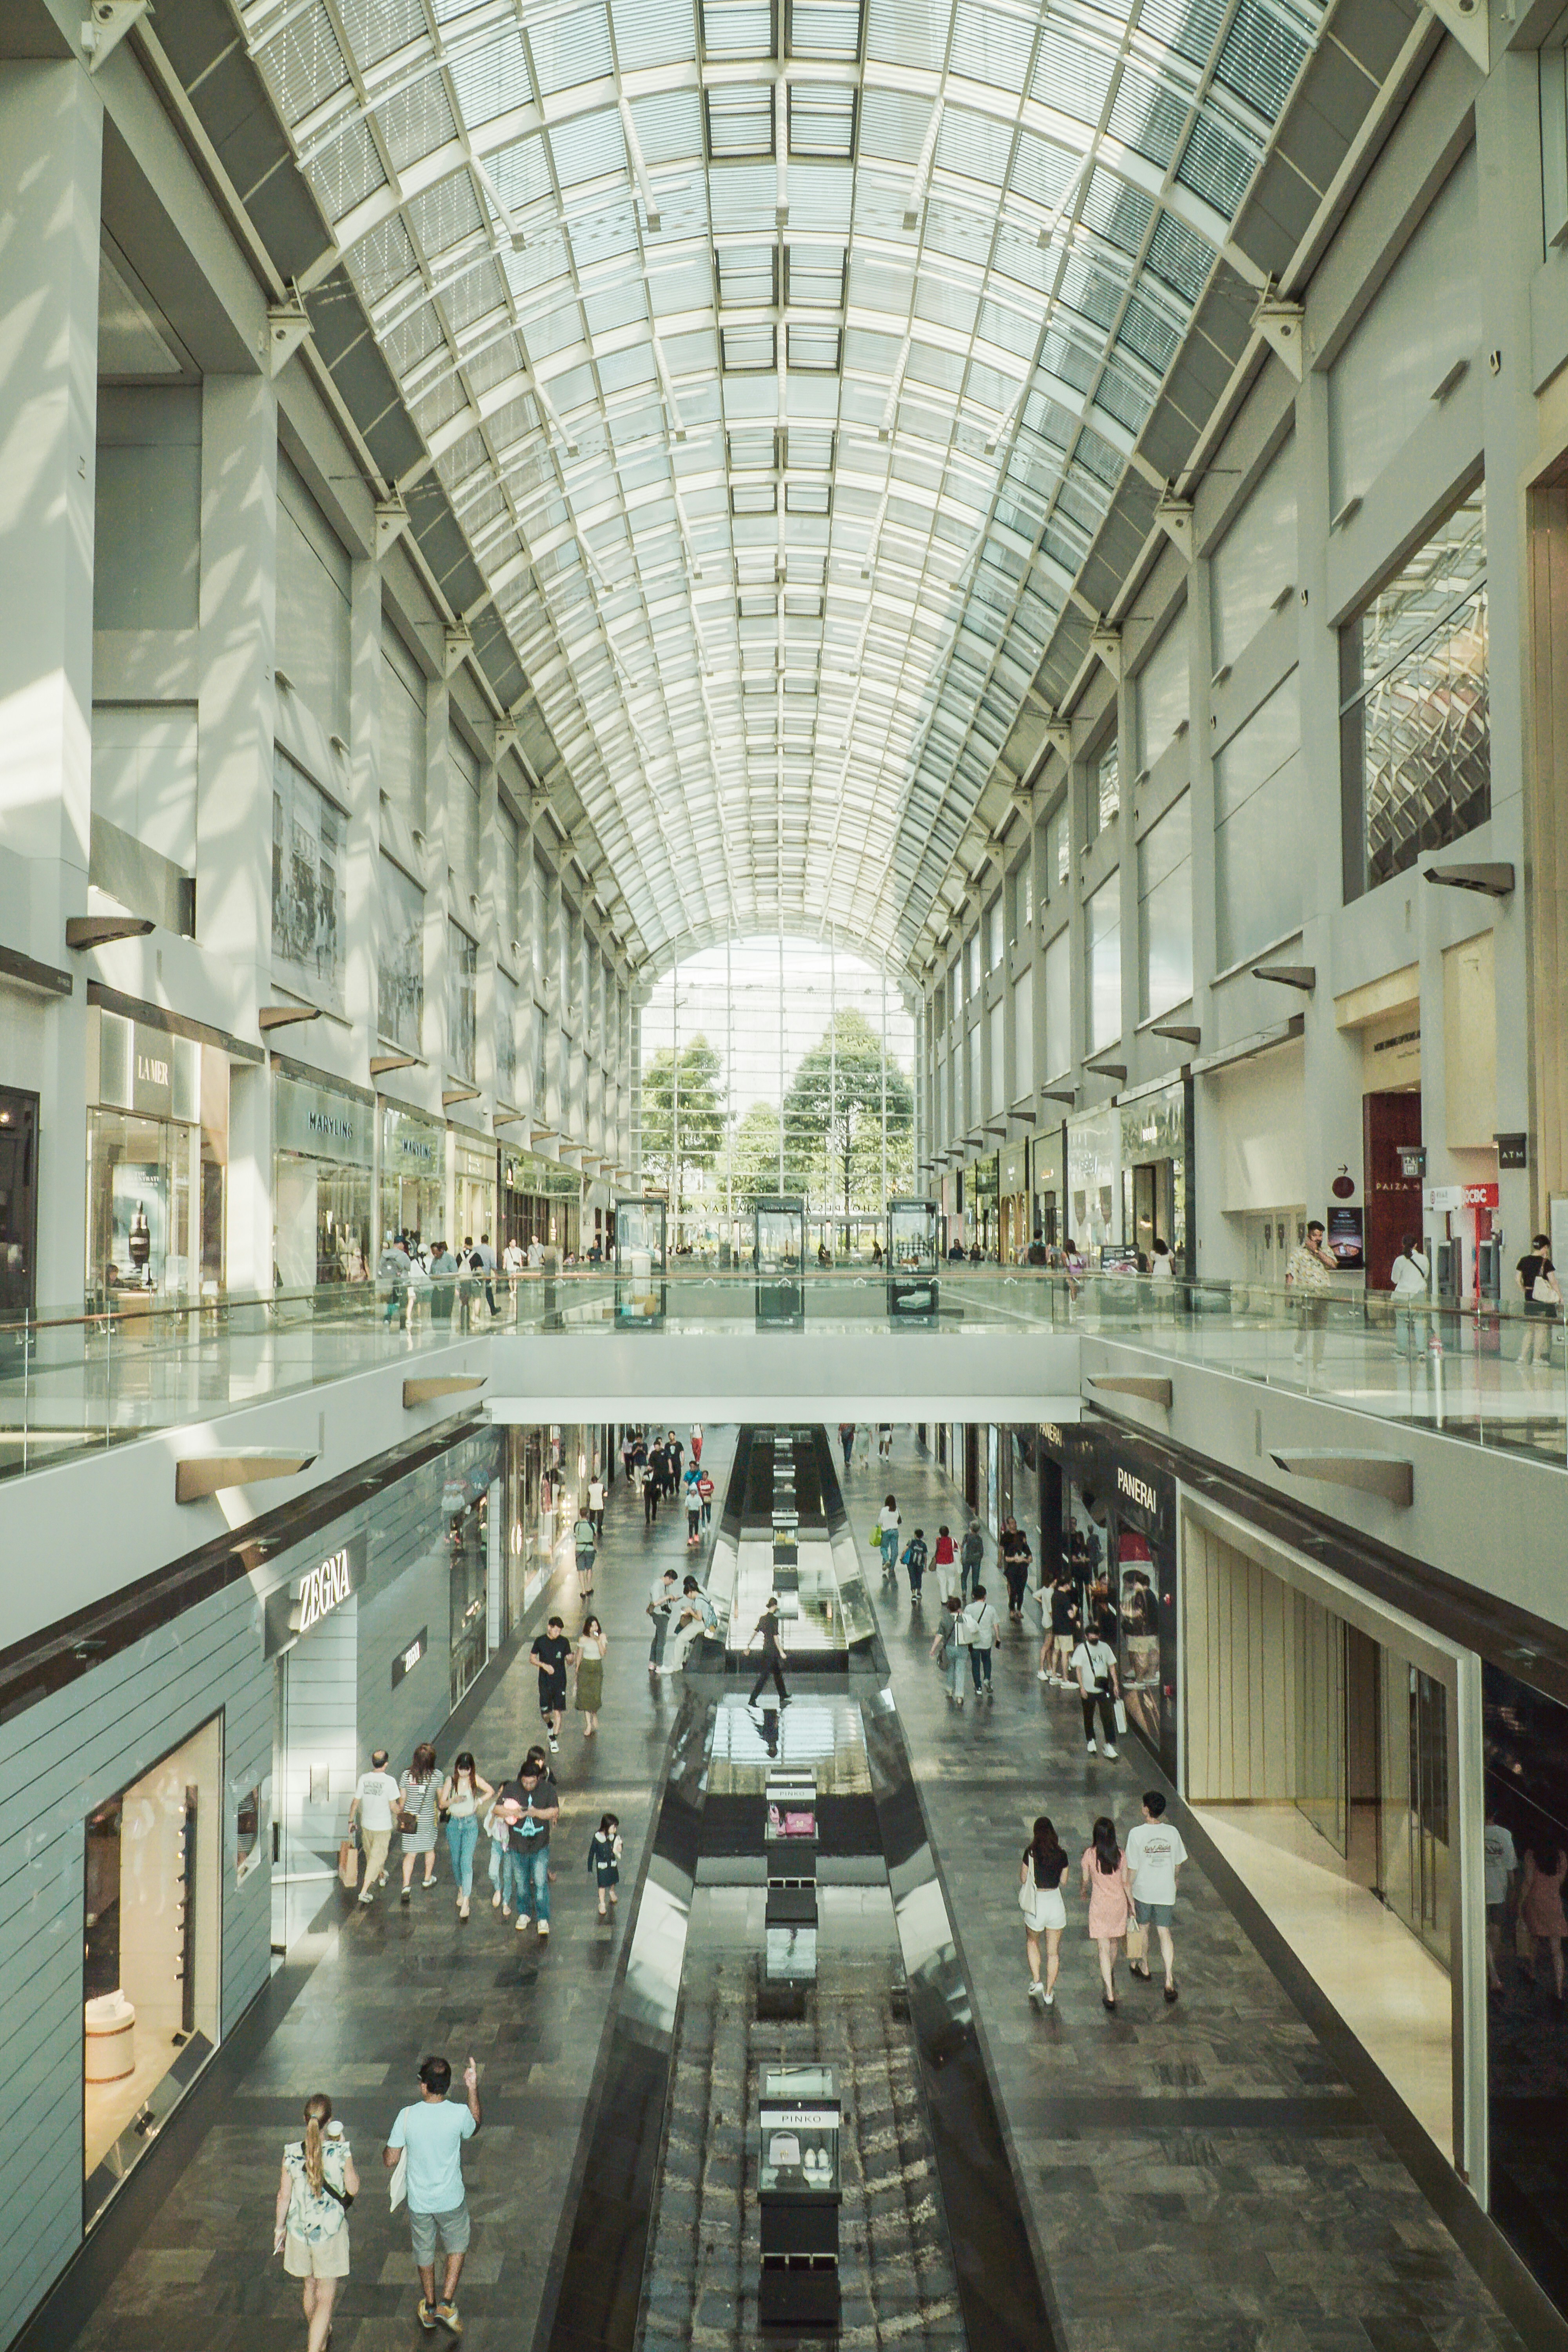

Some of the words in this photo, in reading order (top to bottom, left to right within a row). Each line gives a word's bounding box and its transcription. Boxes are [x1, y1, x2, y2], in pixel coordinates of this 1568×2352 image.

[308, 1111, 352, 1138] MARYLING
[1118, 1467, 1156, 1514] PANERAI
[299, 1549, 351, 1633] ZEGNA
